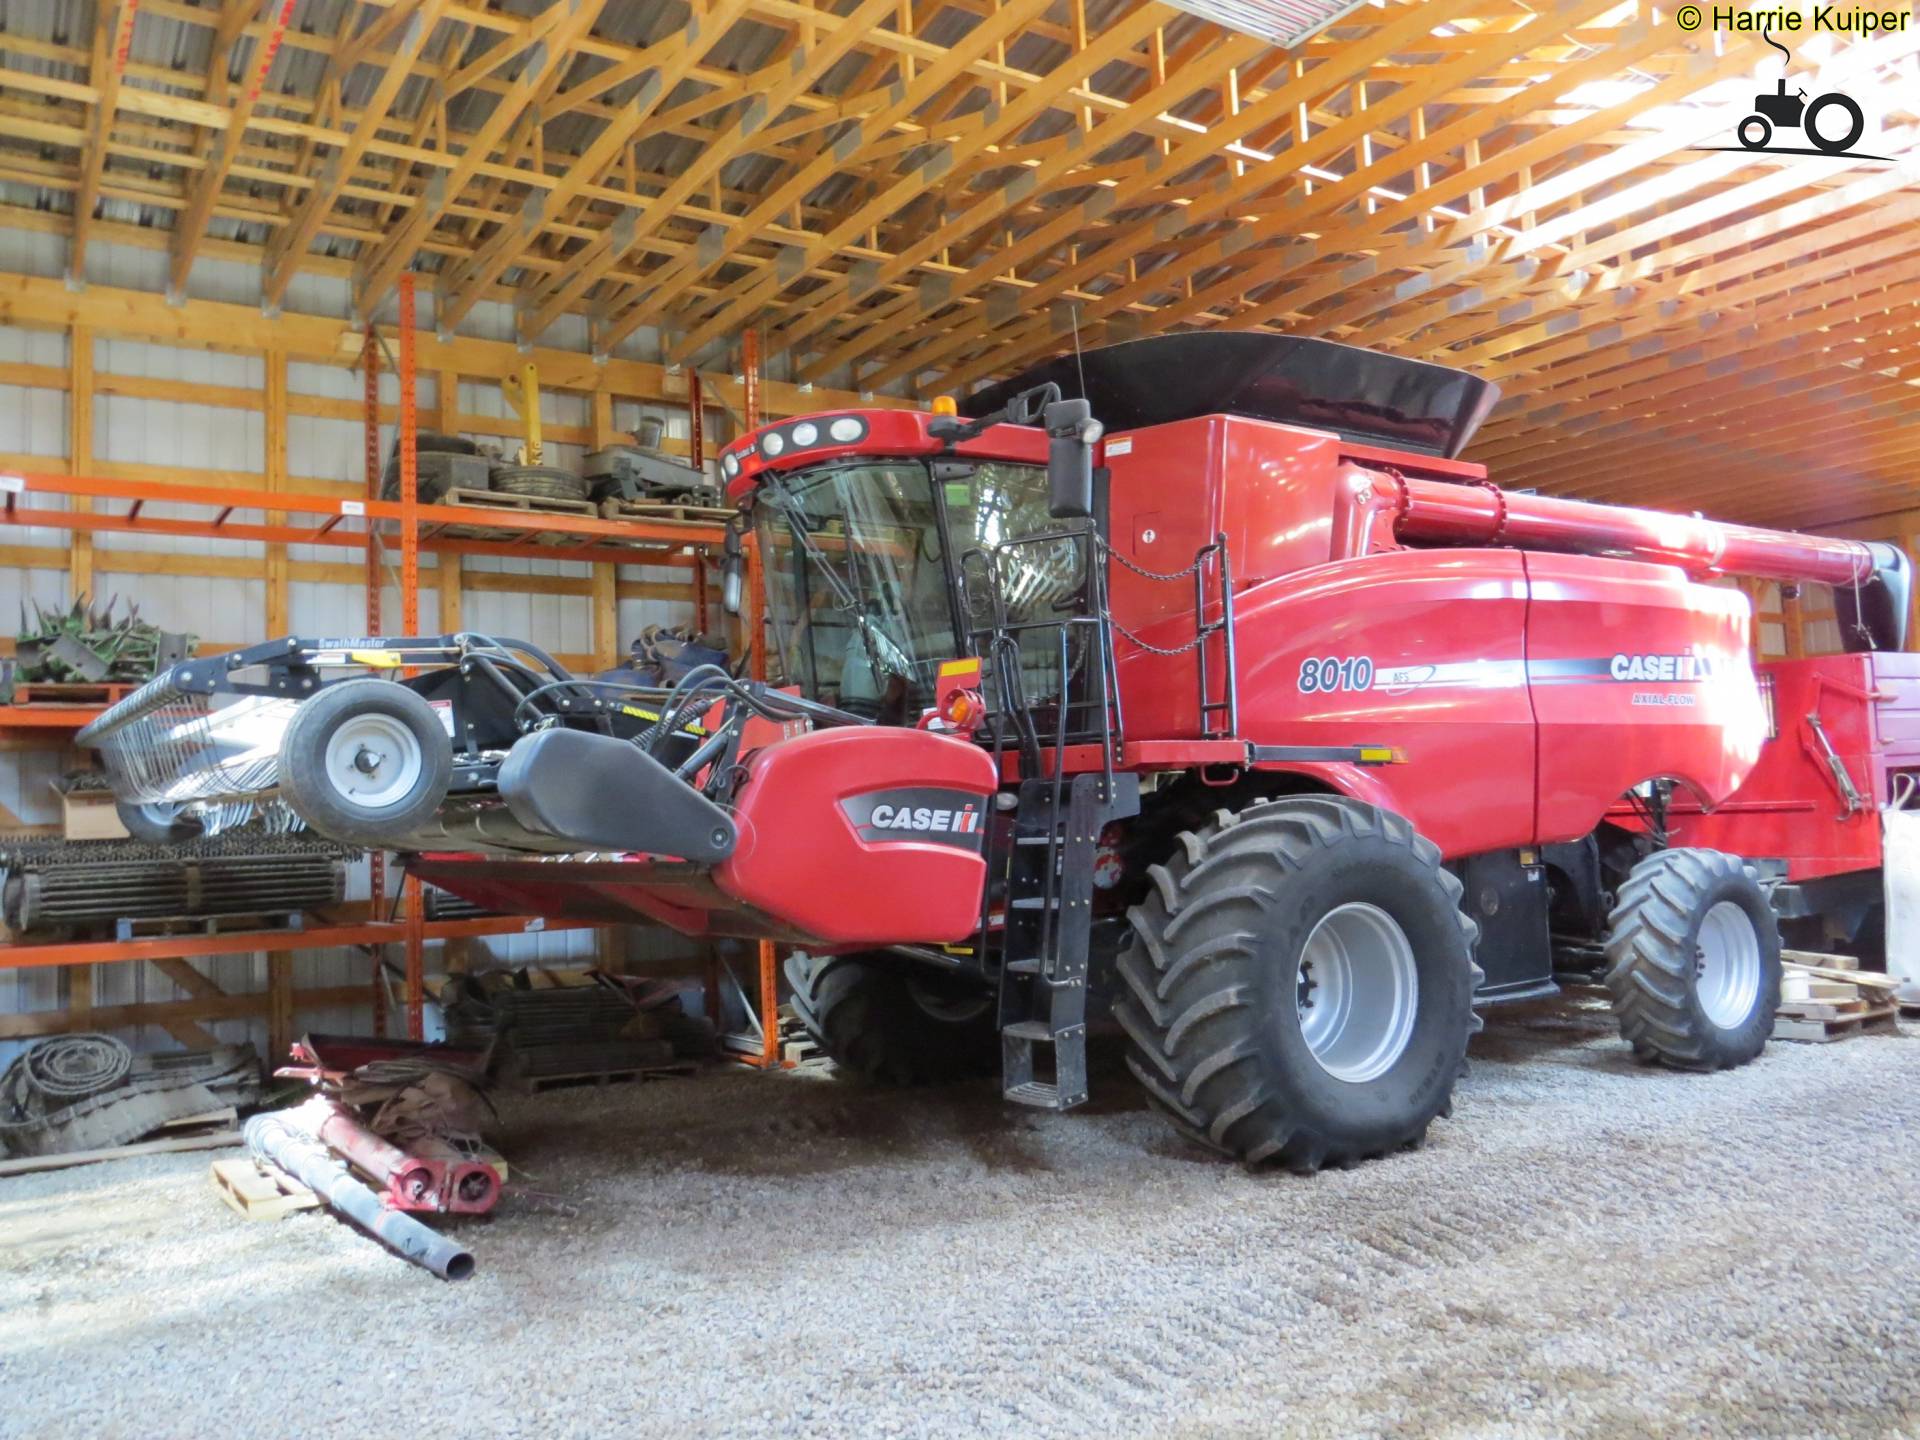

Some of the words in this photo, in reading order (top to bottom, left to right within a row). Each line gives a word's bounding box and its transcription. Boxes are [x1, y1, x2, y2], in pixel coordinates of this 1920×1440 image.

[1297, 656, 1373, 694] 8010
[1610, 654, 1675, 681] CASE
[871, 804, 951, 832] CASE
